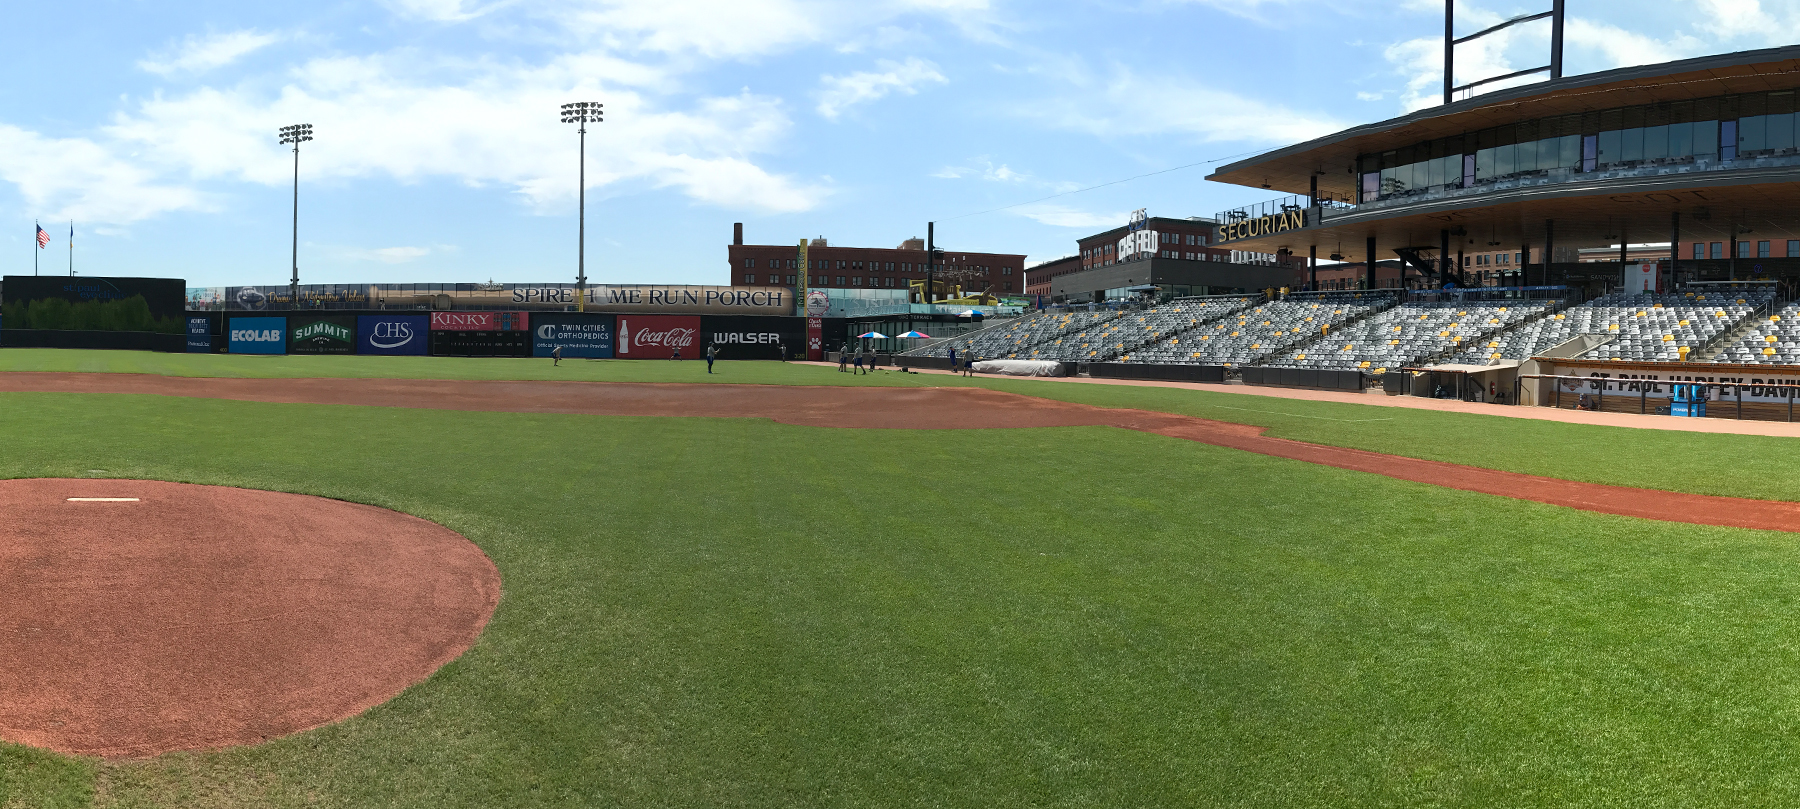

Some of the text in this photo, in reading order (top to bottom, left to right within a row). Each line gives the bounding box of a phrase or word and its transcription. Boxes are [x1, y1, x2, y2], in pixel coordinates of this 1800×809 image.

[1218, 210, 1304, 243] SECURIAN
[1118, 230, 1159, 261] CHS FIELD
[78, 284, 100, 293] paul
[512, 288, 574, 304] SPIRE
[648, 290, 698, 304] RUN
[706, 290, 782, 307] PORCH
[432, 312, 489, 326] KINKY
[232, 330, 280, 342] ECOLAB
[296, 322, 348, 339] SUMMIT
[374, 322, 409, 338] CHS
[634, 328, 696, 347] Coca-Cola
[714, 332, 780, 344] WALSER
[1590, 372, 1612, 391] ST.
[1618, 374, 1662, 392] PAUL
